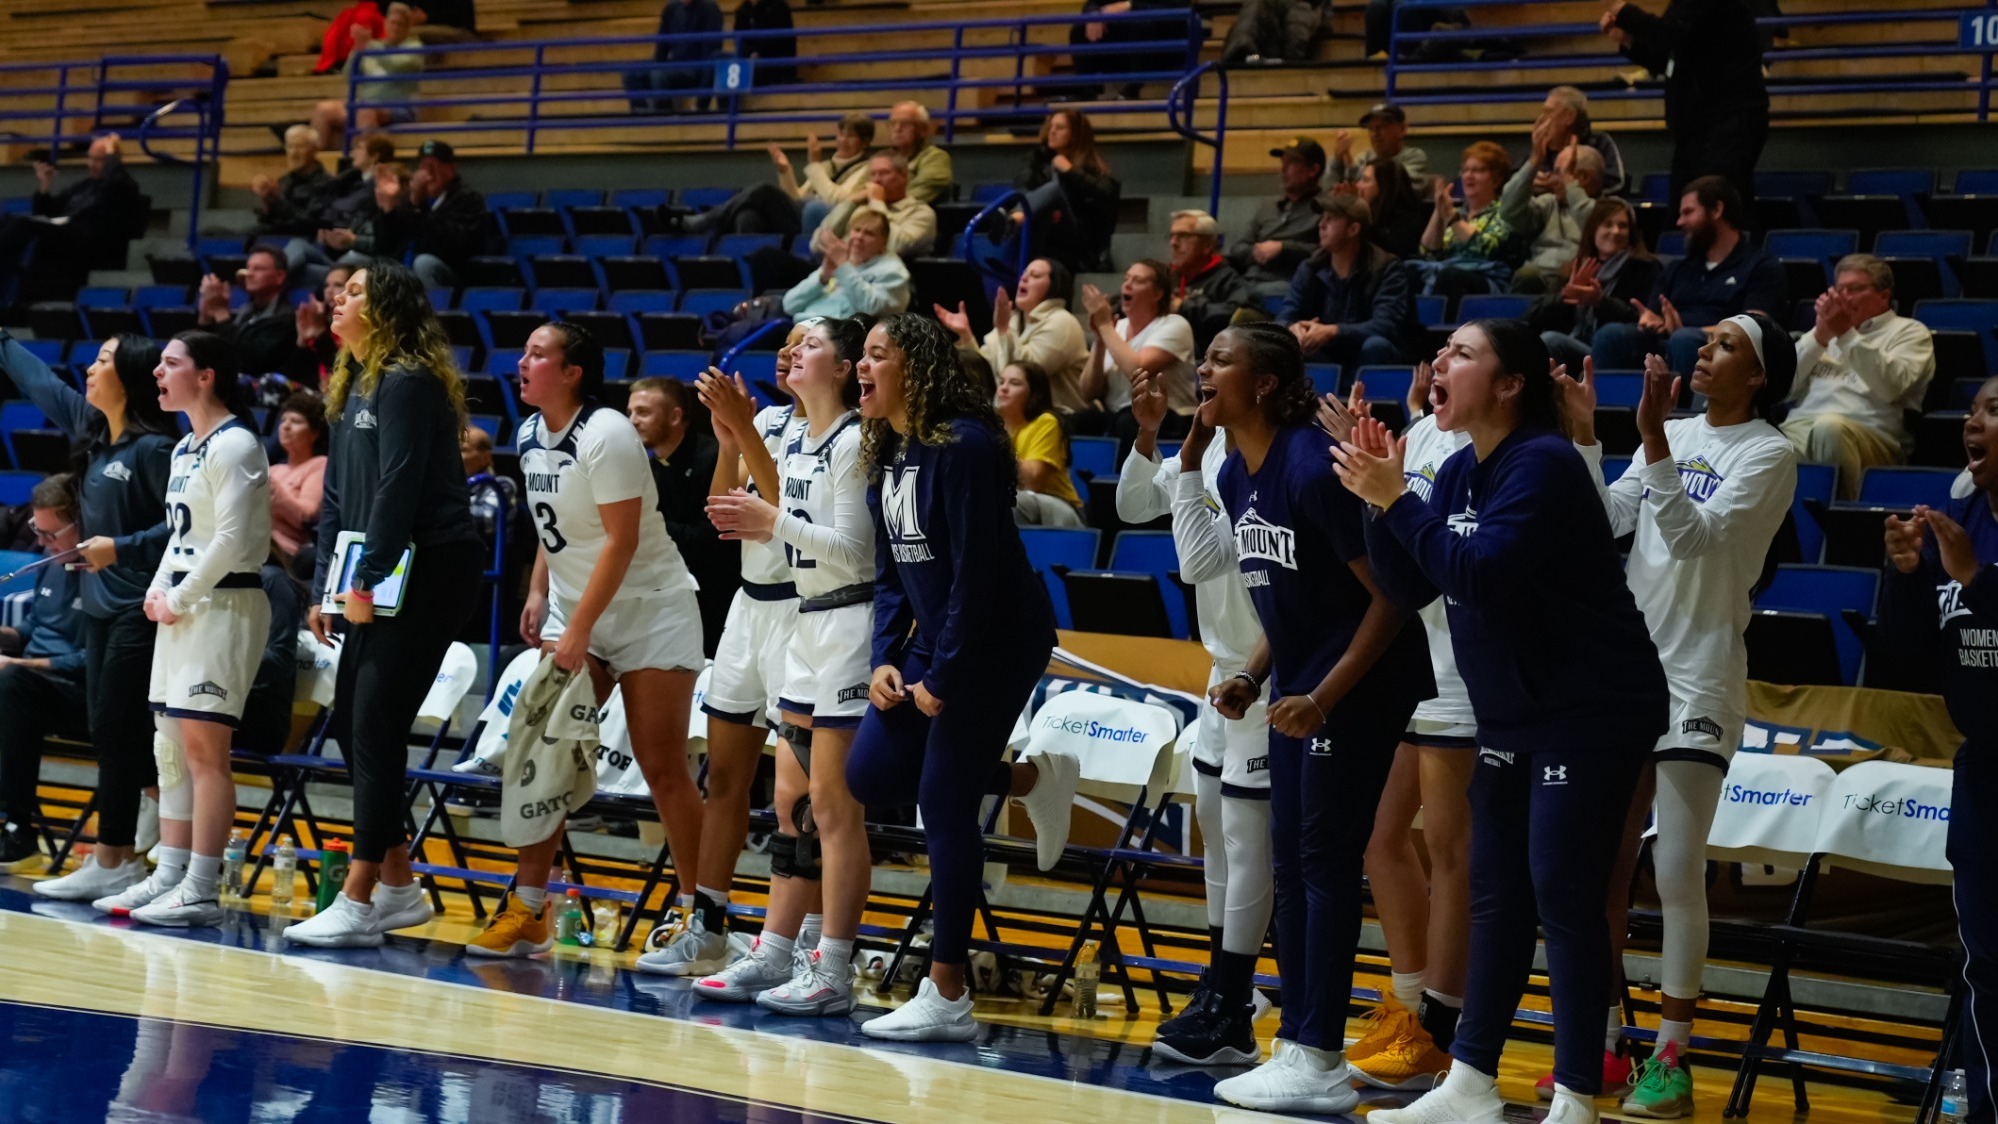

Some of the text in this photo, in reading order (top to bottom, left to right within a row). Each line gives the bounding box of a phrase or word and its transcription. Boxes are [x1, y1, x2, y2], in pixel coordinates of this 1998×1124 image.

[1971, 15, 1998, 45] 10
[727, 63, 741, 89] 8
[528, 472, 560, 493] MOUNT
[784, 477, 812, 501] MUNT
[882, 466, 926, 540] M
[535, 502, 567, 554] 3
[1240, 528, 1295, 565] MOUNT
[839, 689, 856, 702] THE
[1042, 715, 1149, 743] TicketSmarter
[1683, 721, 1698, 733] THE
[1248, 759, 1265, 772] THE
[1721, 784, 1812, 806] tSmarter
